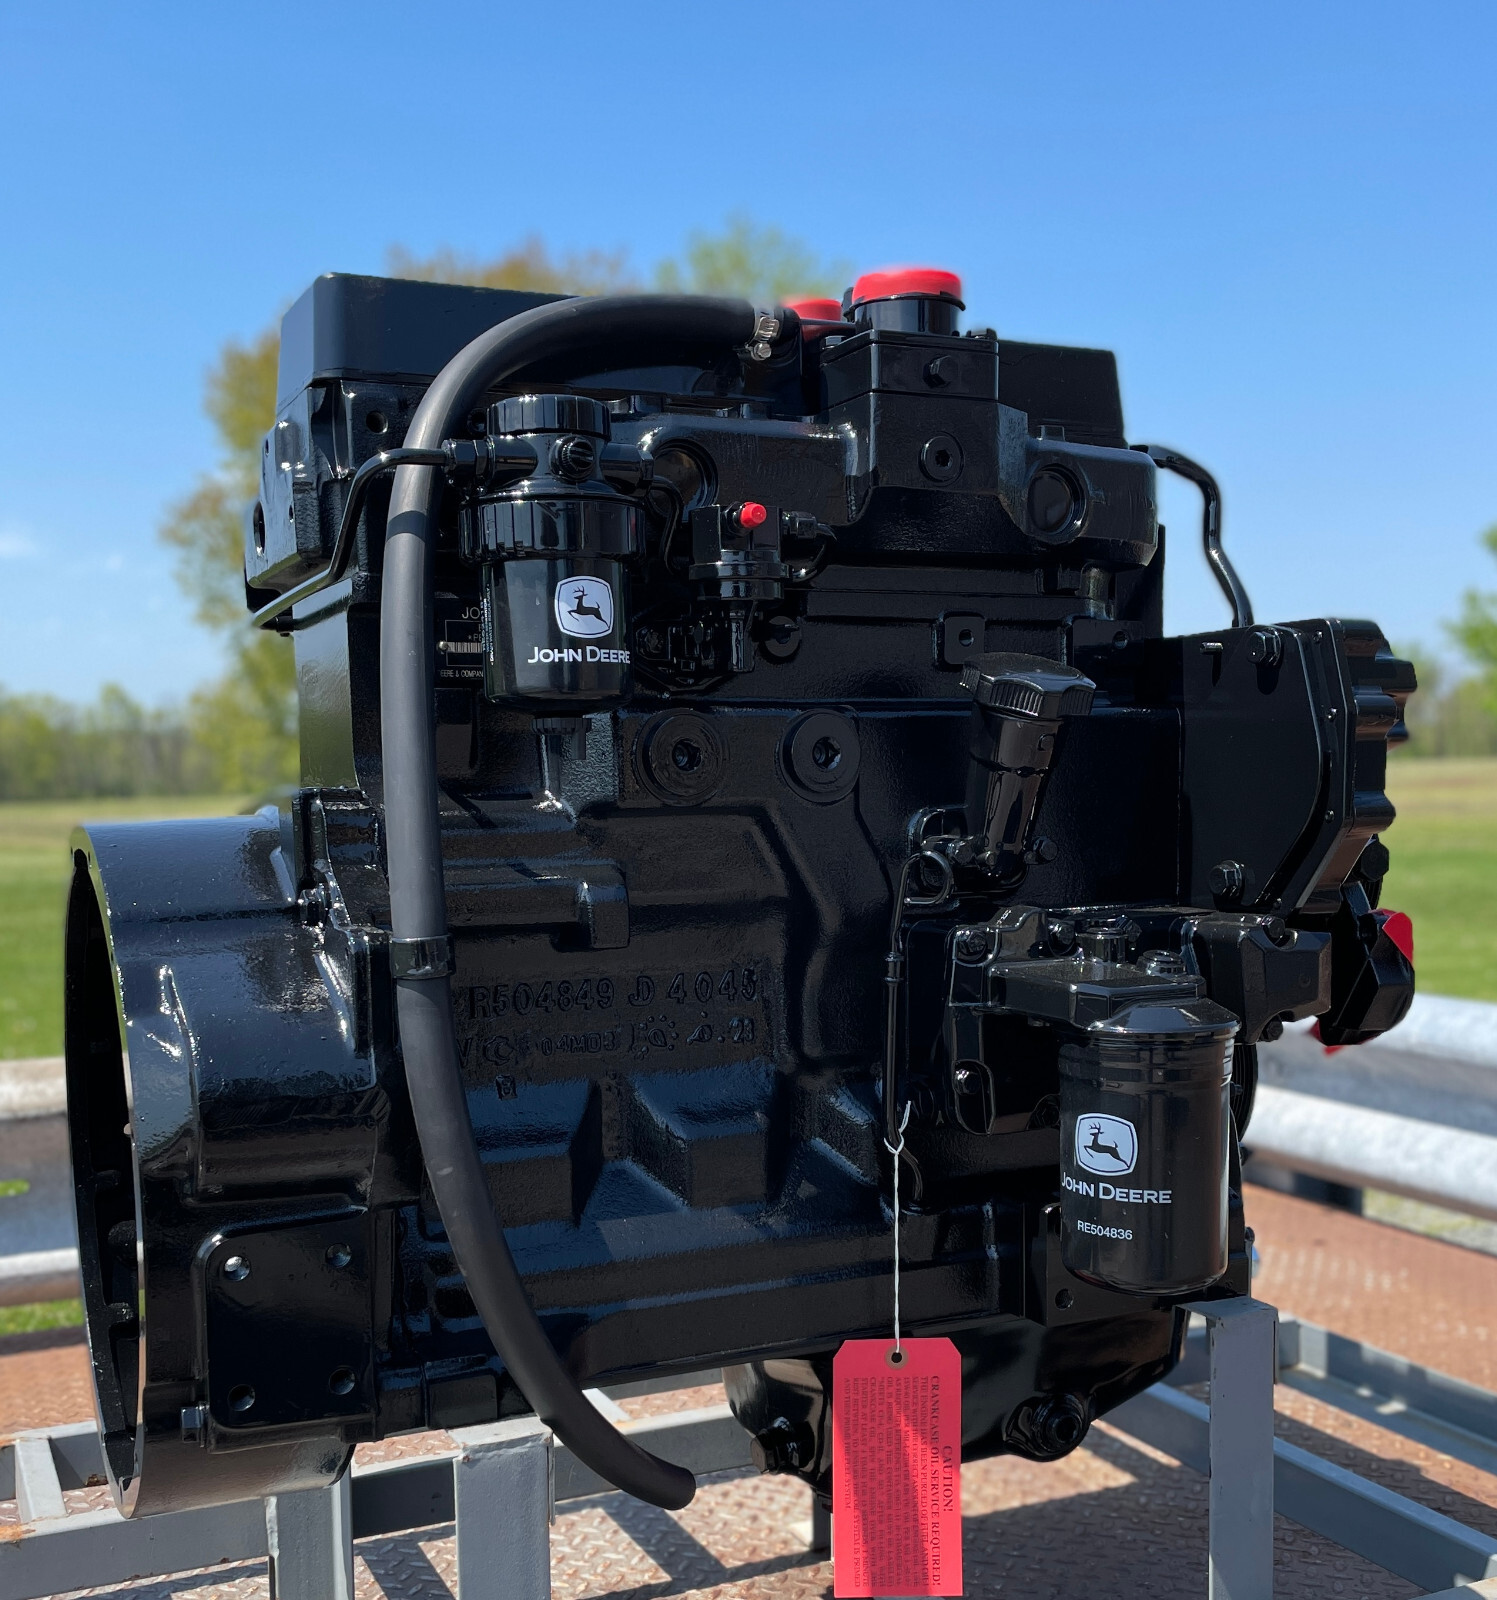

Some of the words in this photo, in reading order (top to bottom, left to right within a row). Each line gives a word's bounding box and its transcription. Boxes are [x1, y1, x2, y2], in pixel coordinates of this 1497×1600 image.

[528, 646, 582, 664] JOHN
[586, 646, 631, 664] DEERE
[461, 670, 484, 678] COMPAN
[468, 978, 614, 1019] R504849
[1062, 1172, 1094, 1198] JOHN
[1098, 1182, 1172, 1204] DEERE
[1077, 1220, 1133, 1240] RE504836
[930, 1376, 940, 1444] CRANKCASE
[930, 1447, 940, 1467] OIL
[931, 1469, 940, 1518] SERVICE
[943, 1446, 953, 1512] CAUTION!
[921, 1509, 928, 1520] OF
[931, 1522, 941, 1586] REQUIRED!
